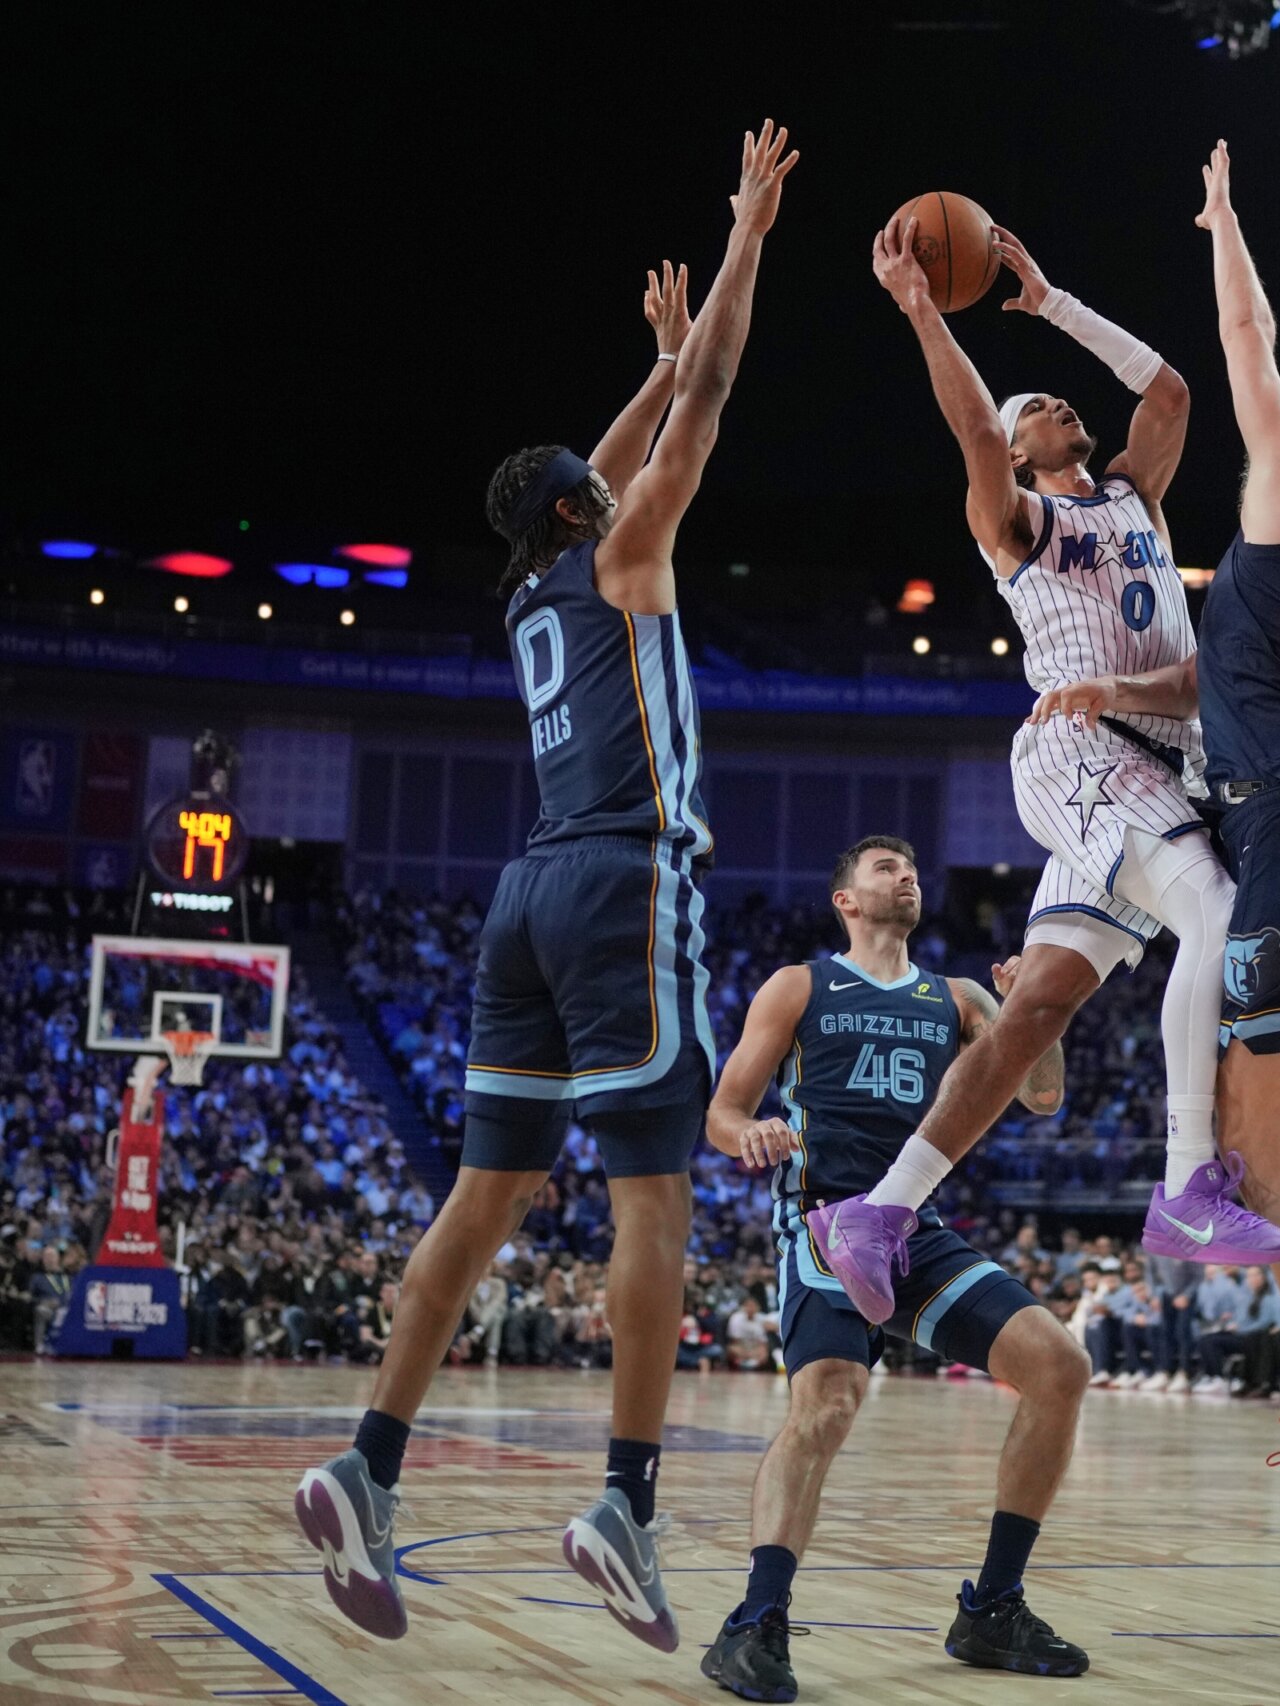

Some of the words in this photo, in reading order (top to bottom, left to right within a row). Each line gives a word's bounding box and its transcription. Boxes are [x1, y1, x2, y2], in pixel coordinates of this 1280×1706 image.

[1121, 581, 1156, 632] 0
[516, 606, 564, 713] 0
[179, 811, 232, 841] 4:04
[183, 836, 224, 882] 17
[820, 1014, 949, 1046] GRIZZLIES
[846, 1043, 926, 1104] 46
